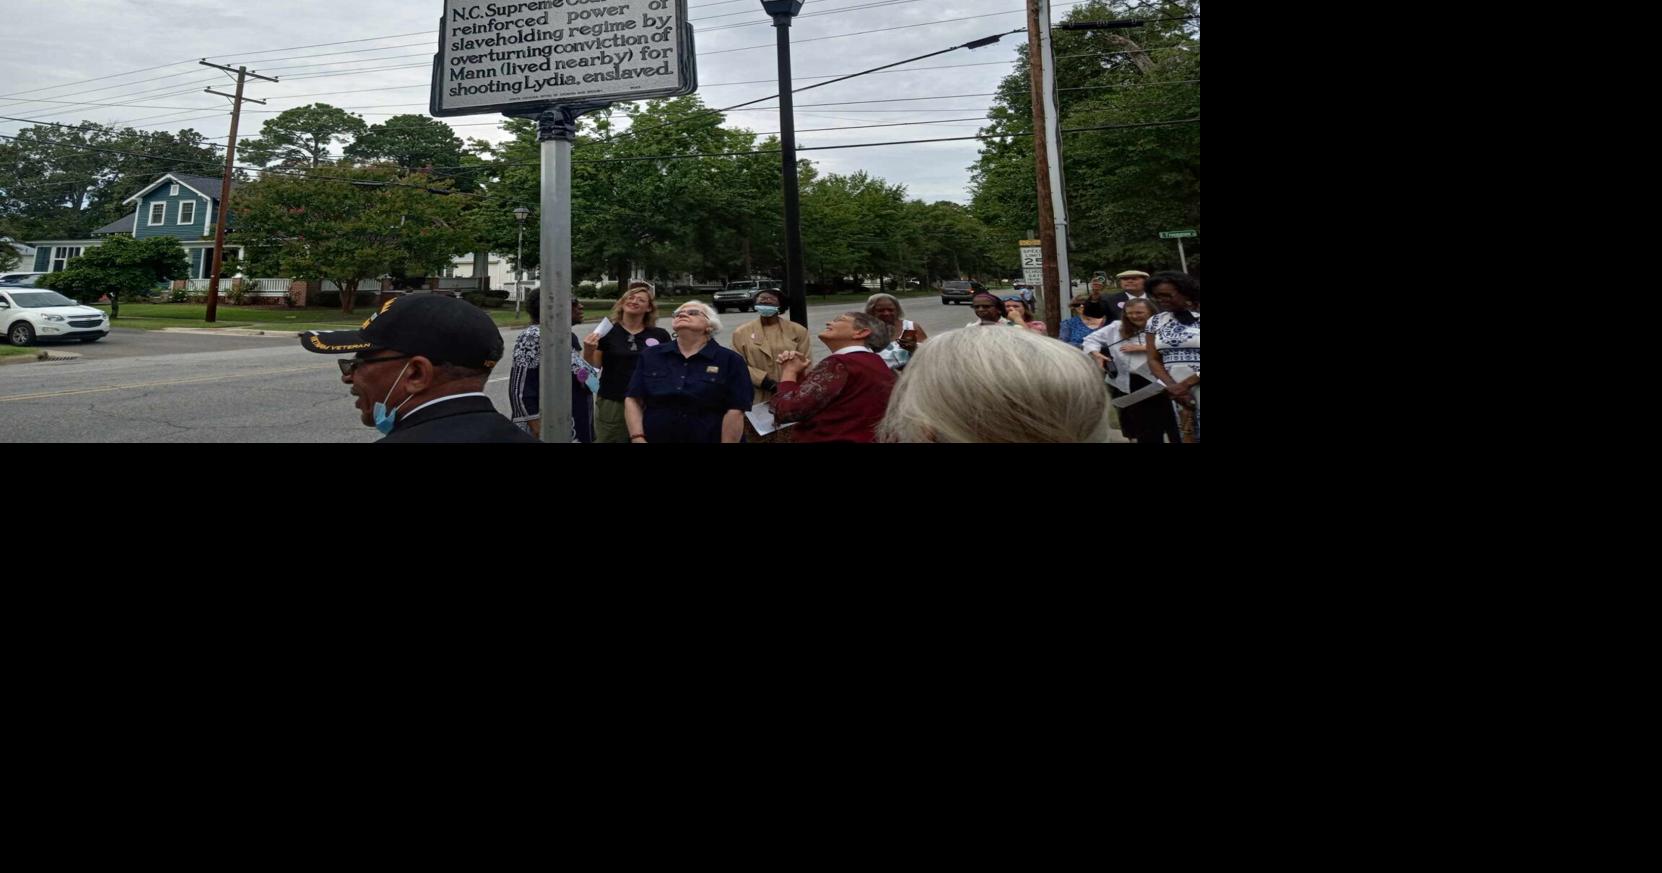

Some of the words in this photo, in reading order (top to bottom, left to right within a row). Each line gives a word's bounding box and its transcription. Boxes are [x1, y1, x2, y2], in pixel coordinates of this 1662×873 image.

[452, 11, 549, 37] reinforced
[567, 4, 630, 24] power
[485, 0, 564, 17] Supreme
[451, 28, 564, 51] slaveholding
[569, 19, 637, 37] regime
[642, 13, 672, 30] by
[450, 43, 553, 66] overturning
[554, 33, 649, 55] conviction
[651, 26, 673, 43] of
[449, 67, 497, 82] Mann
[501, 57, 551, 77] (lived
[555, 49, 634, 70] nearby)
[640, 46, 673, 61] for
[449, 81, 523, 97] shooting
[1024, 257, 1043, 266] 25
[331, 343, 371, 351] VETERAN
